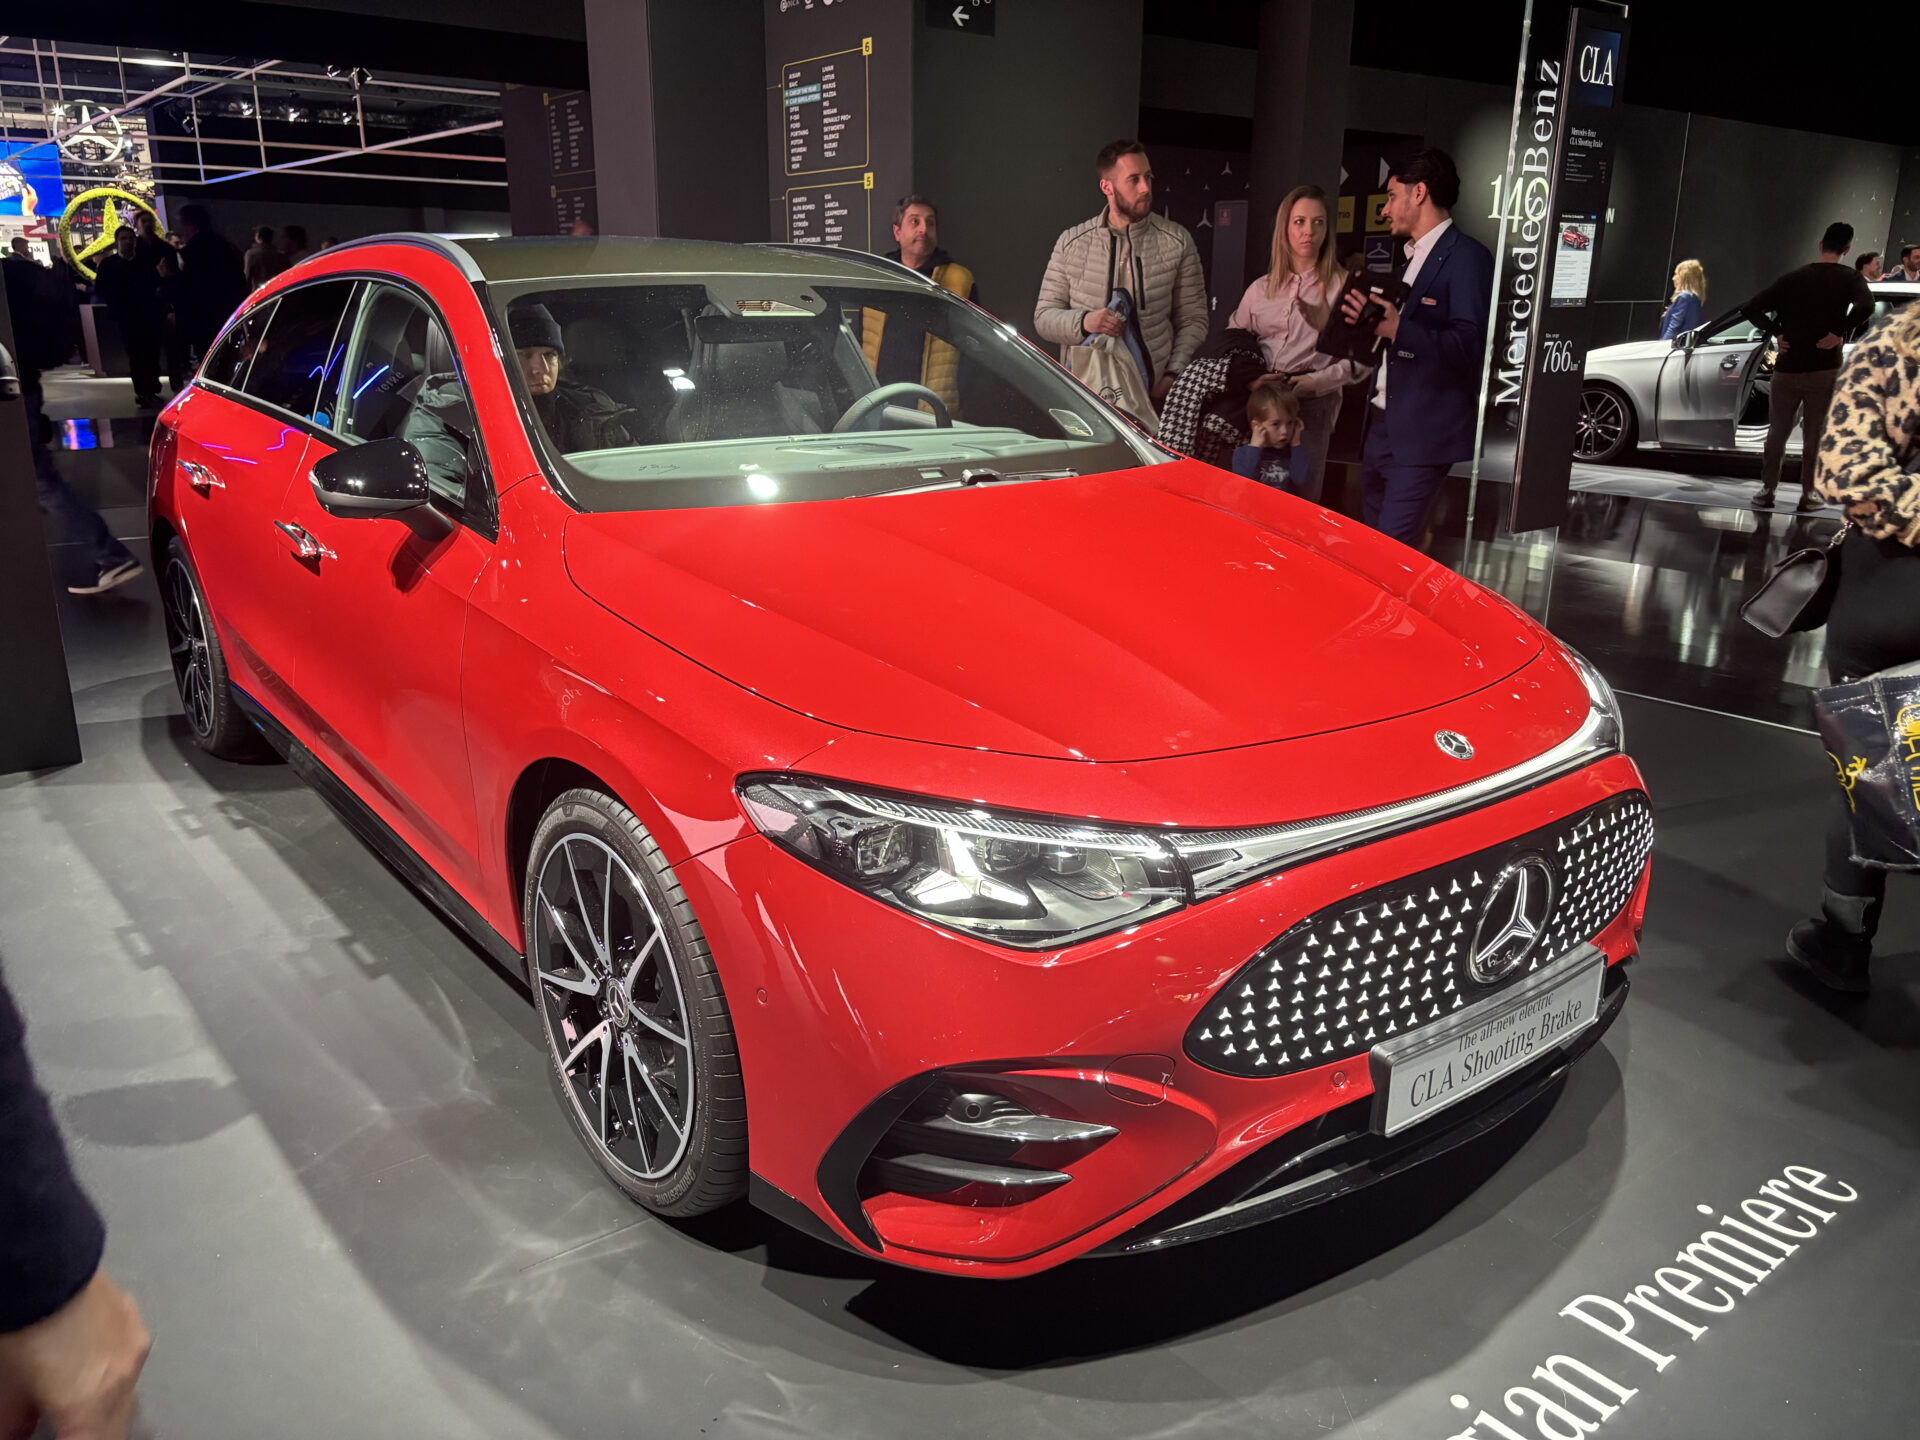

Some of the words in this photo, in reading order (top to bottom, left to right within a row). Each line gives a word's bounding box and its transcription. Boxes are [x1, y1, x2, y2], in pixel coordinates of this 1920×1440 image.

[1580, 45, 1614, 87] CLA
[1494, 58, 1561, 406] Mercedes-Benz
[1542, 340, 1573, 373] 766
[1410, 1060, 1454, 1107] CLA
[1461, 1027, 1537, 1084] Shooting
[1539, 1000, 1583, 1041] Brake
[1458, 1032, 1478, 1052] The
[1480, 1013, 1517, 1042] all-new
[1519, 993, 1555, 1021] electric
[1558, 1165, 1858, 1373] Premiere
